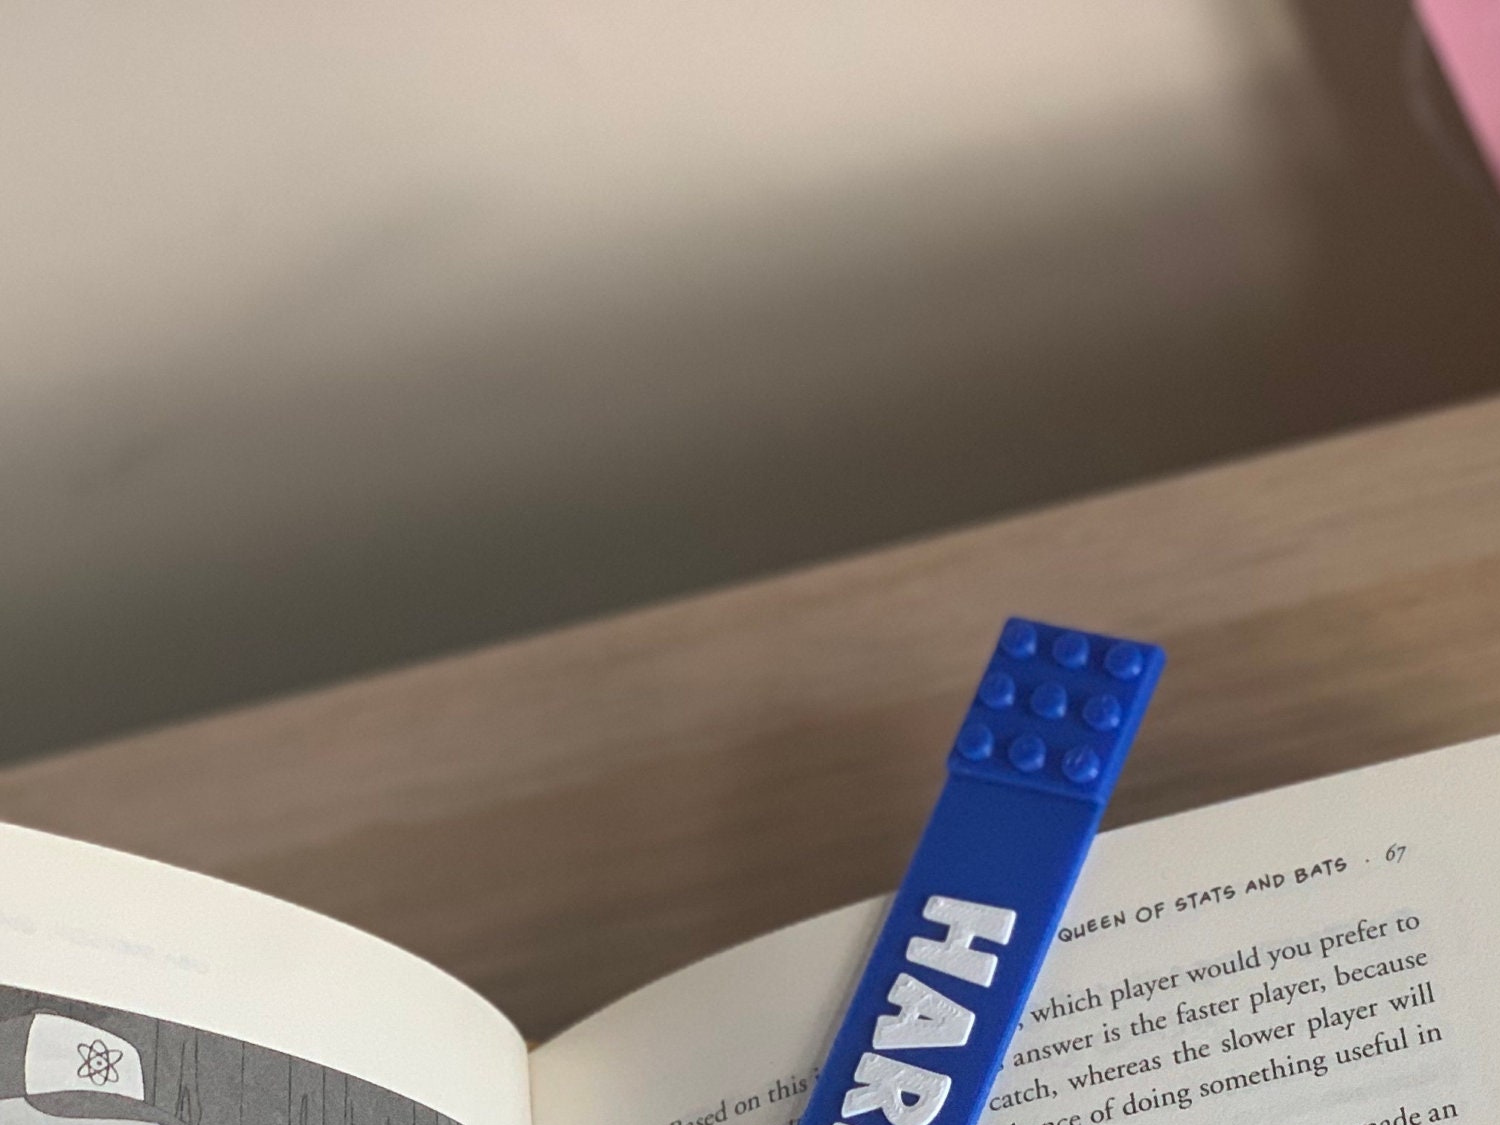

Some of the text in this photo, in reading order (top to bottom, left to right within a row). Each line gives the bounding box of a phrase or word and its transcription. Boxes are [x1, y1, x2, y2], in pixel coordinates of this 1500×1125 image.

[1057, 843, 1406, 944] QUEEN OF STATS AND BATS 67
[1030, 916, 1419, 1022] which player would you prefer to
[1428, 1102, 1459, 1125] an
